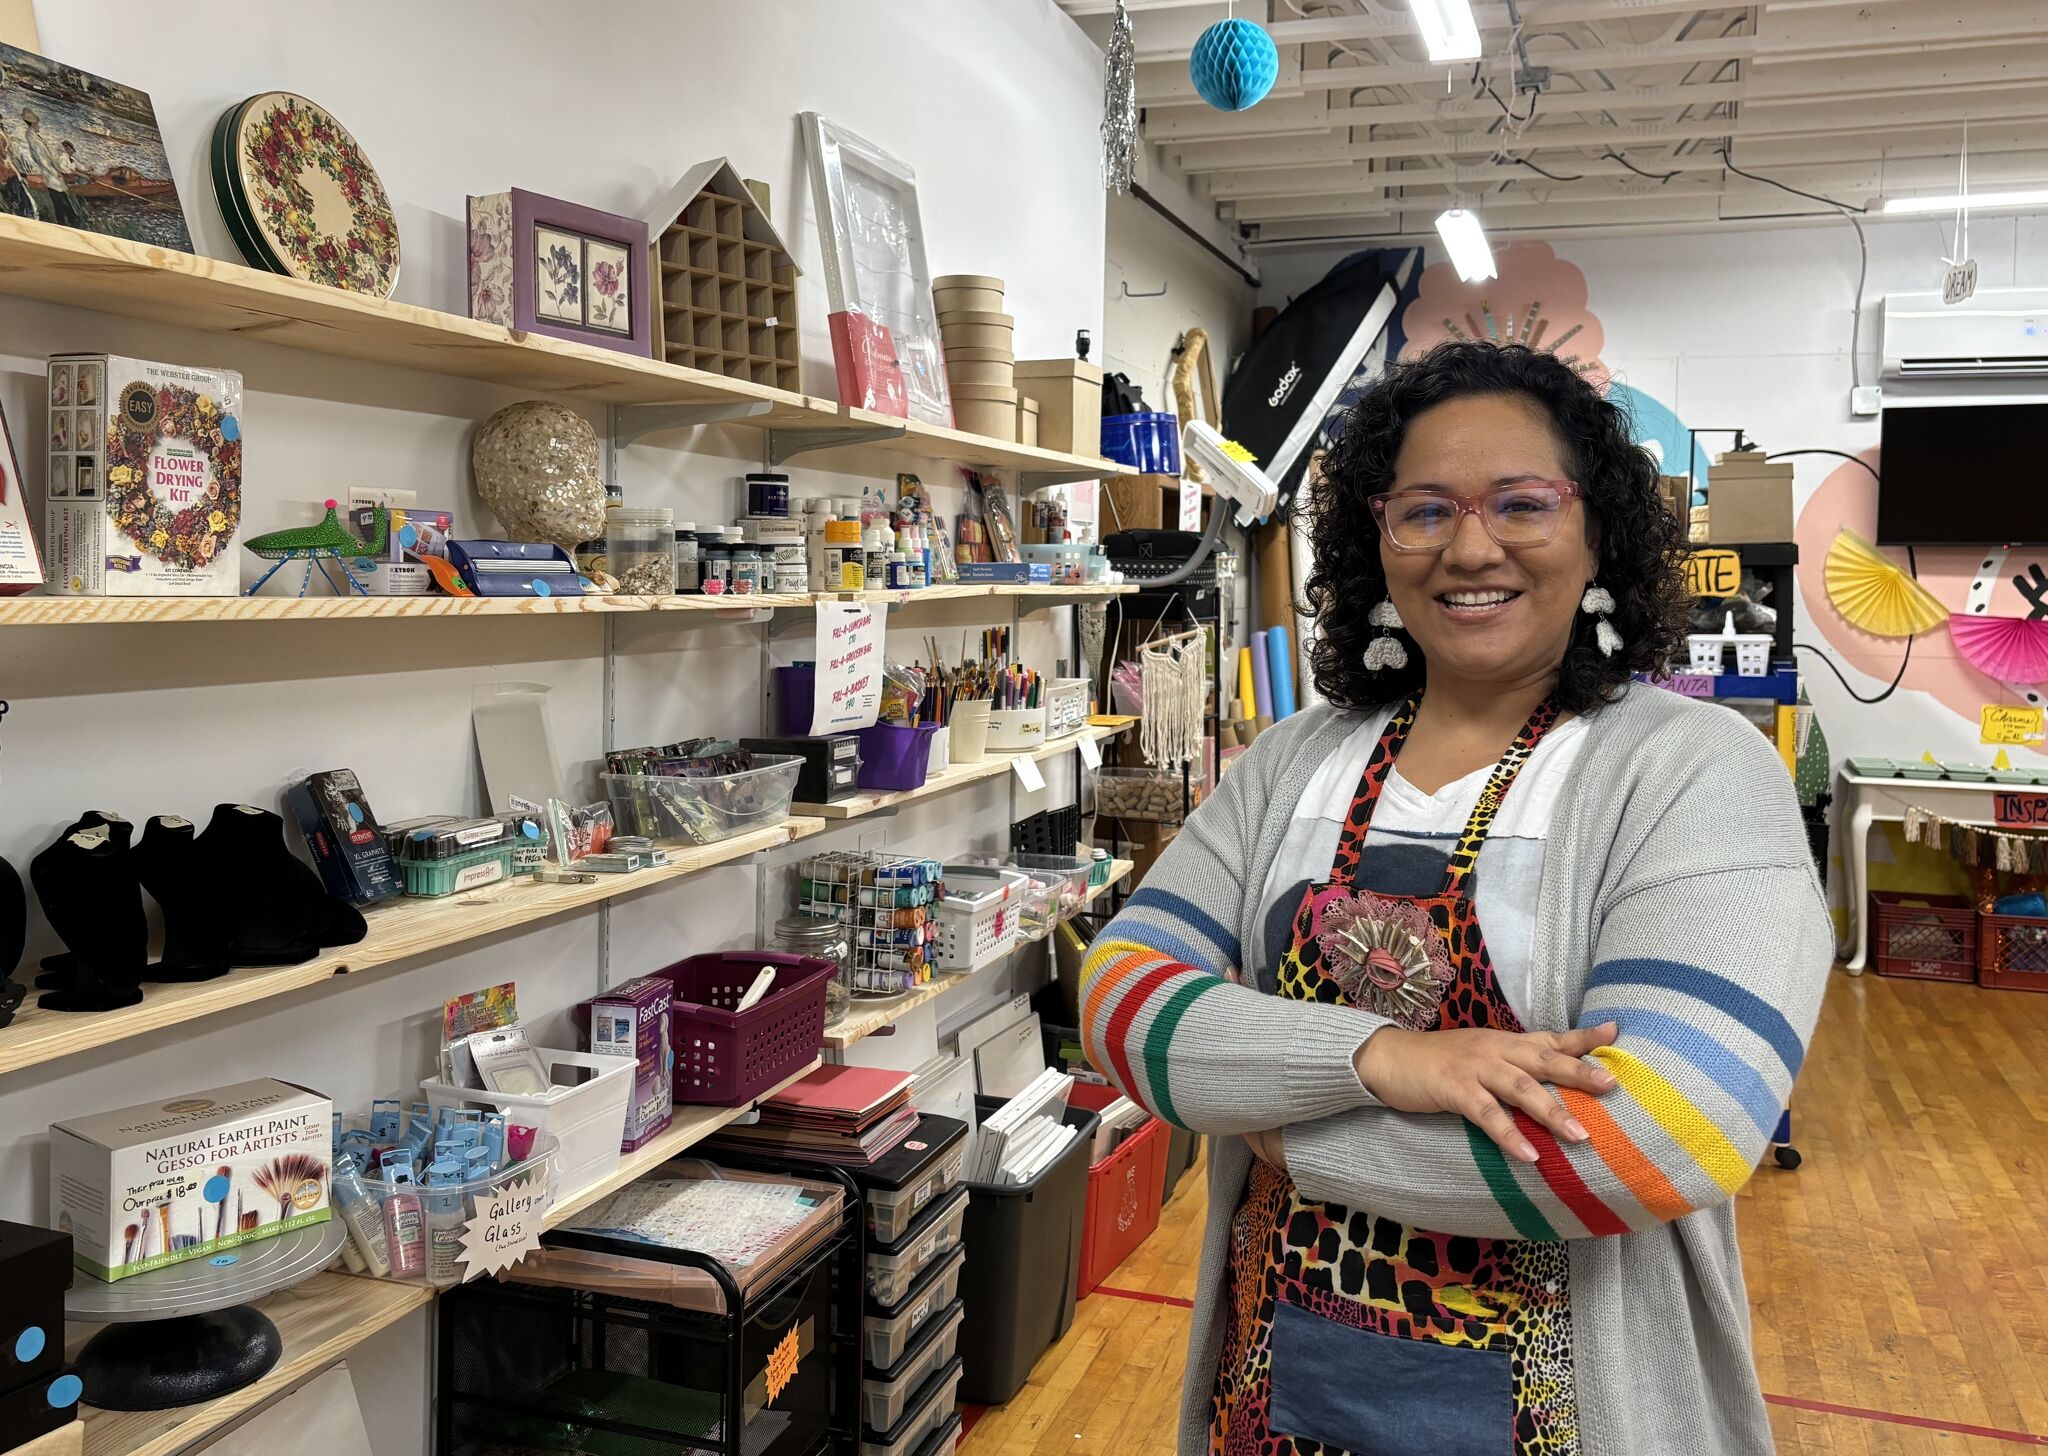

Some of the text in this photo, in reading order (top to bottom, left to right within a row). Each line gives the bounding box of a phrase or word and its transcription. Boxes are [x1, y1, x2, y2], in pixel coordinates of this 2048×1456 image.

[1946, 270, 1973, 299] DREAM
[160, 370, 190, 380] WEBSTER
[191, 375, 212, 384] GROUP
[1268, 363, 1301, 407] Godox
[130, 400, 153, 414] EASY
[154, 456, 204, 472] FLOWER
[156, 472, 203, 488] DRYING
[170, 488, 190, 502] KIT
[1686, 555, 1735, 592] ATE
[832, 614, 872, 640] FILL-A-LUNCH BAG
[830, 642, 872, 671] FILL-A-GROCERY BAG
[832, 675, 870, 704] FILL-A-BASKET
[1666, 679, 1708, 692] ANTA
[351, 832, 373, 842] DERWENT
[362, 848, 384, 858] GRAPHITE
[464, 866, 495, 883] ImpressArt
[639, 993, 669, 1024] FastCast
[118, 1114, 186, 1132] NATURAL
[190, 1112, 218, 1121] FOR
[146, 1114, 309, 1163] NATURAL EARTH PAINT
[157, 1130, 298, 1174] GESSO FOR ARTISTS
[149, 1179, 165, 1190] price
[123, 1198, 145, 1212] Our
[146, 1196, 164, 1206] price
[490, 1196, 531, 1220] Gallery
[485, 1222, 521, 1242] Glass
[133, 1253, 182, 1272] ECO-FRIENDLY
[188, 1244, 211, 1255] VEGAN
[217, 1232, 256, 1248] NON-TOXIC
[262, 1225, 283, 1235] MAKES
[285, 1220, 295, 1229] 112
